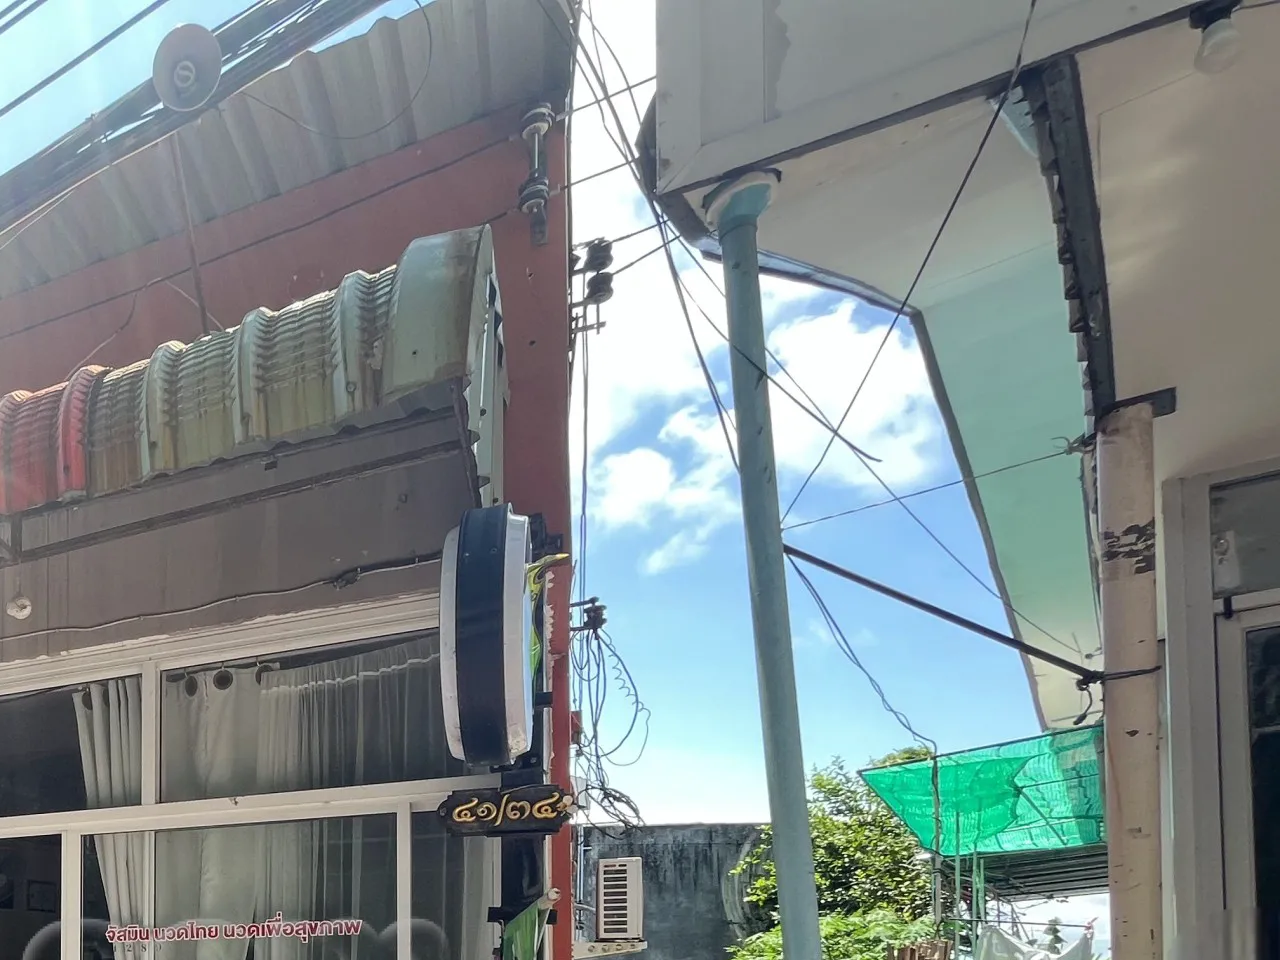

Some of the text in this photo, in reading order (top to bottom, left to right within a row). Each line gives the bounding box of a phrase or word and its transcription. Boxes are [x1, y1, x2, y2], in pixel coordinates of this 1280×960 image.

[105, 911, 363, 944] จัสมิน นวดไทย นวดเพื่อสุขภาพ
